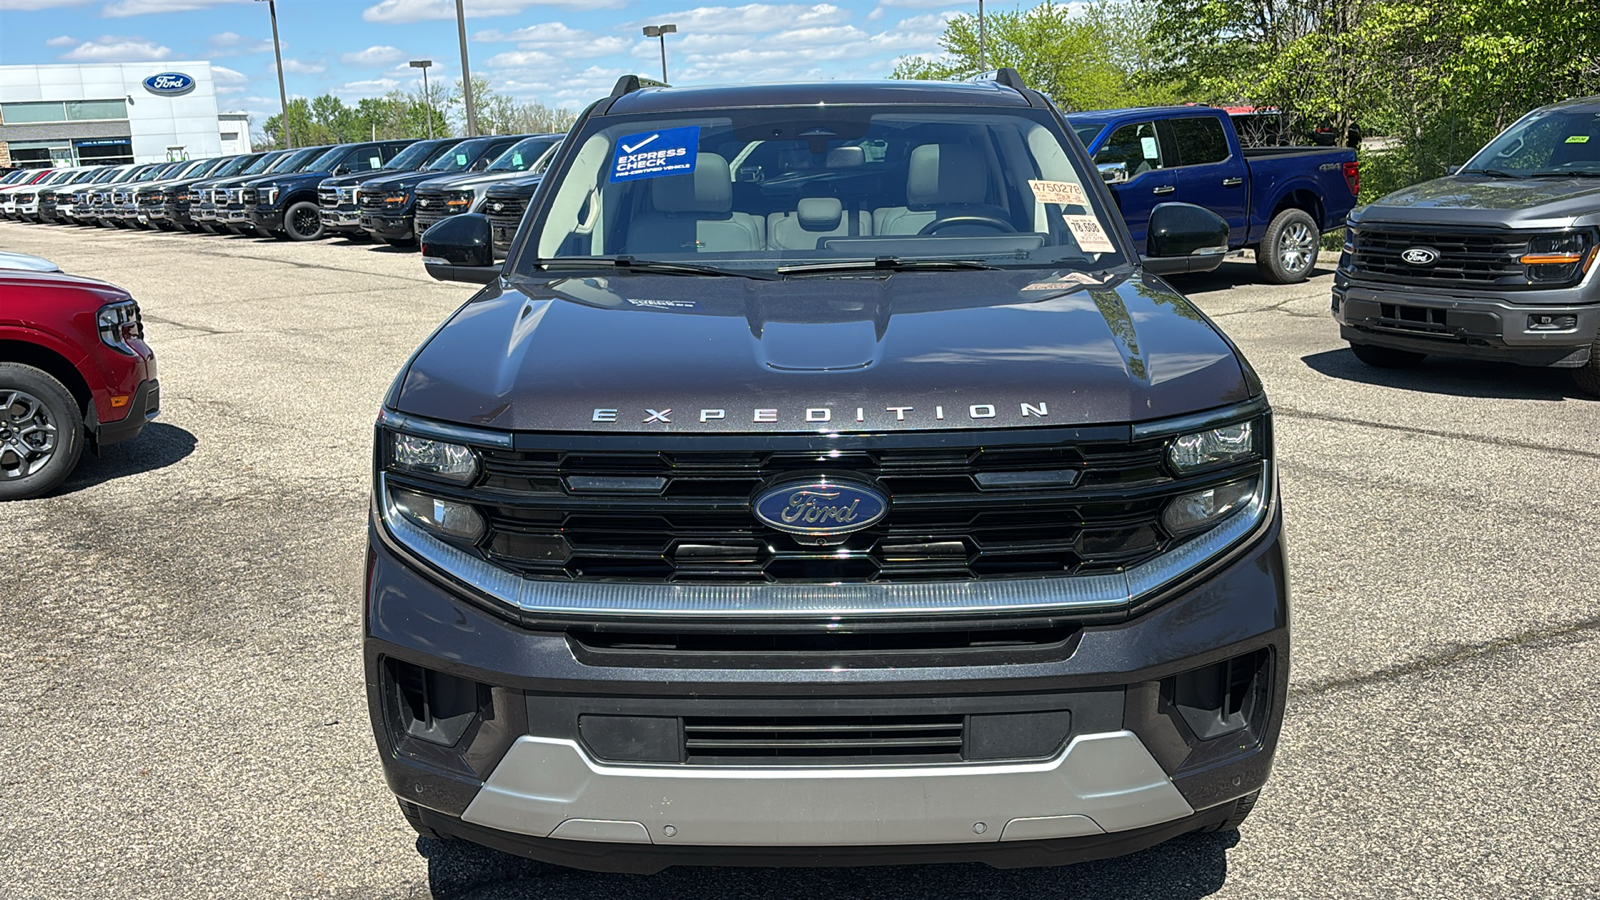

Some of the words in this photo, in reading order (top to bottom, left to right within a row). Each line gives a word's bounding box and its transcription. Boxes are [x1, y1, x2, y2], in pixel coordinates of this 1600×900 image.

[154, 75, 184, 89] Ford
[618, 148, 686, 164] EXPRESS
[616, 158, 666, 171] CHECK
[1033, 182, 1082, 195] 4750278
[1407, 251, 1428, 262] Ford
[592, 402, 1048, 423] EXPEDITION
[781, 491, 860, 523] Ford
